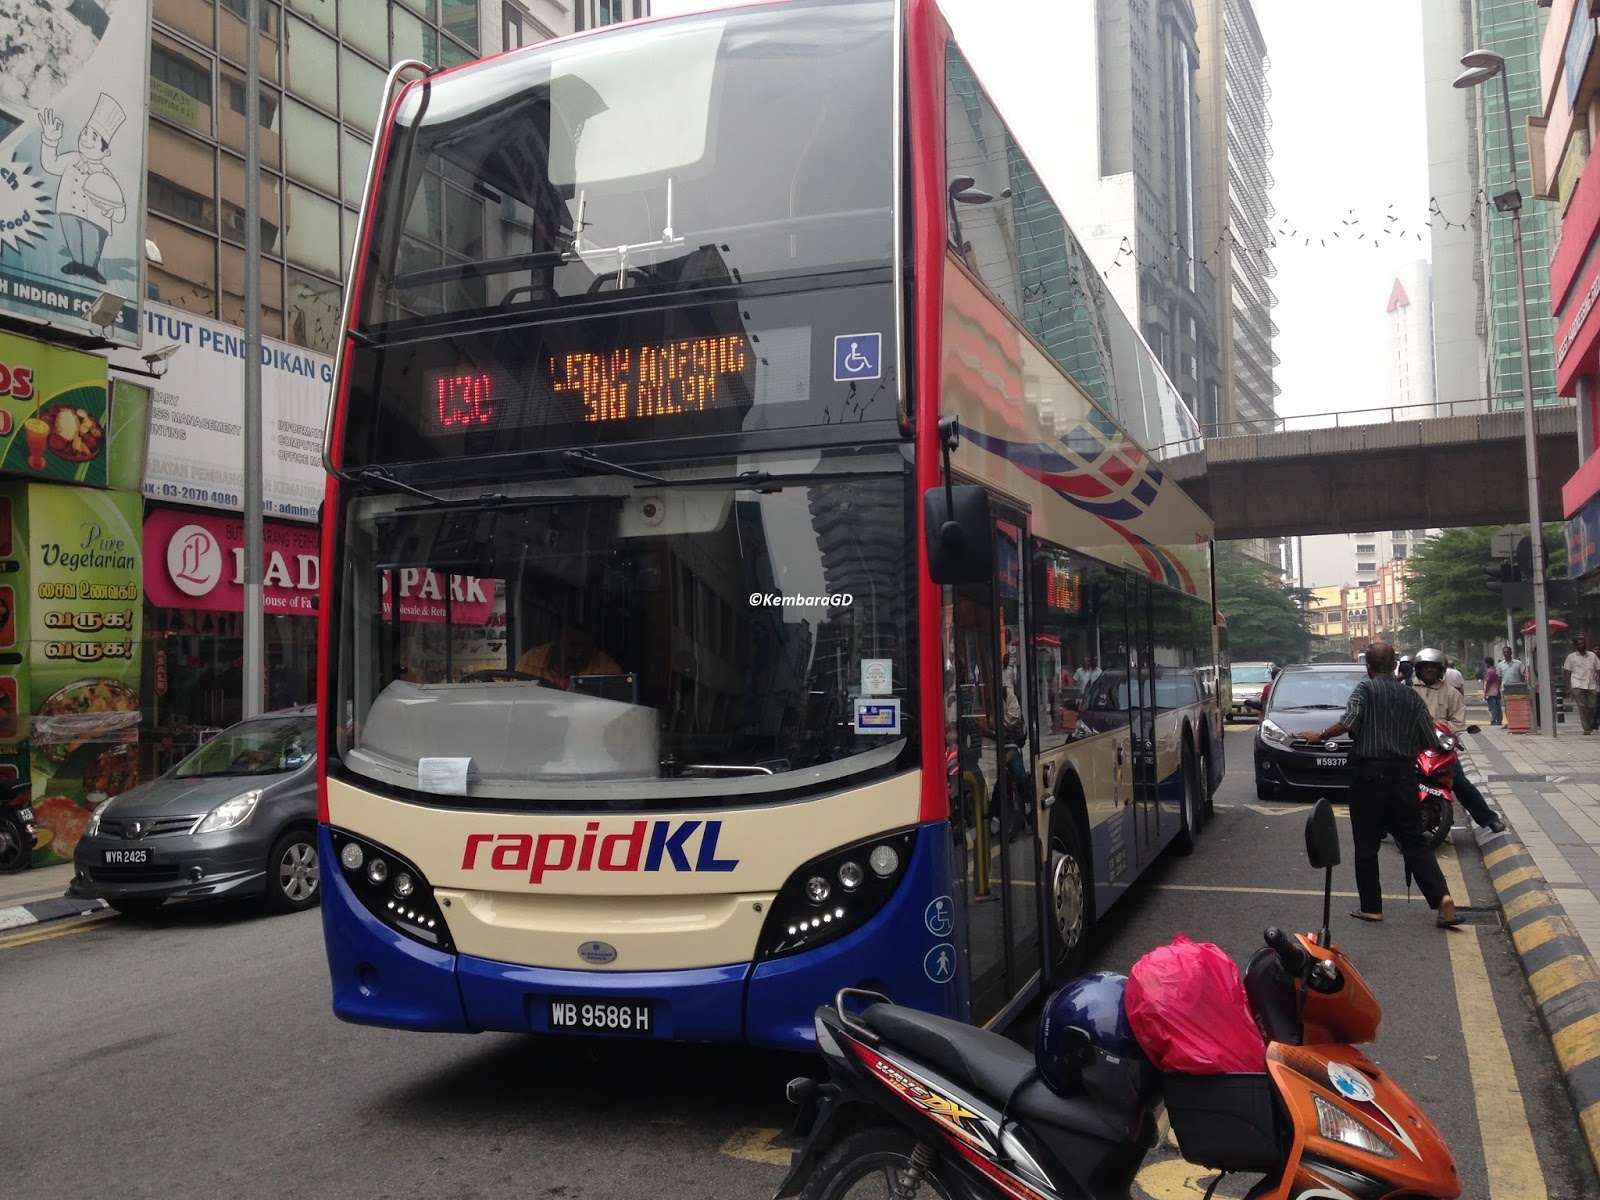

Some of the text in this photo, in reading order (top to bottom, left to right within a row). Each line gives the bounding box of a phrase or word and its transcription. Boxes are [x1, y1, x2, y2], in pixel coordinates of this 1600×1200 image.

[13, 282, 69, 310] INDIAN
[73, 298, 124, 323] FOS
[199, 326, 315, 379] PENDIKAN
[171, 411, 242, 436] MANAGEMENT
[278, 450, 324, 468] OFFICE MA
[162, 483, 208, 501] 03-2070
[210, 491, 238, 506] 4080
[80, 522, 125, 551] Pure
[226, 524, 245, 540] BUT
[41, 543, 134, 571] Vegetarian
[399, 567, 487, 603] PARK
[263, 594, 313, 609] ouse of Fa
[431, 605, 447, 617] Reta
[105, 850, 147, 864] WYR 2425
[461, 821, 740, 884] rapidKL
[552, 1002, 649, 1030] WB 9586 H
[914, 1091, 980, 1129] DX
